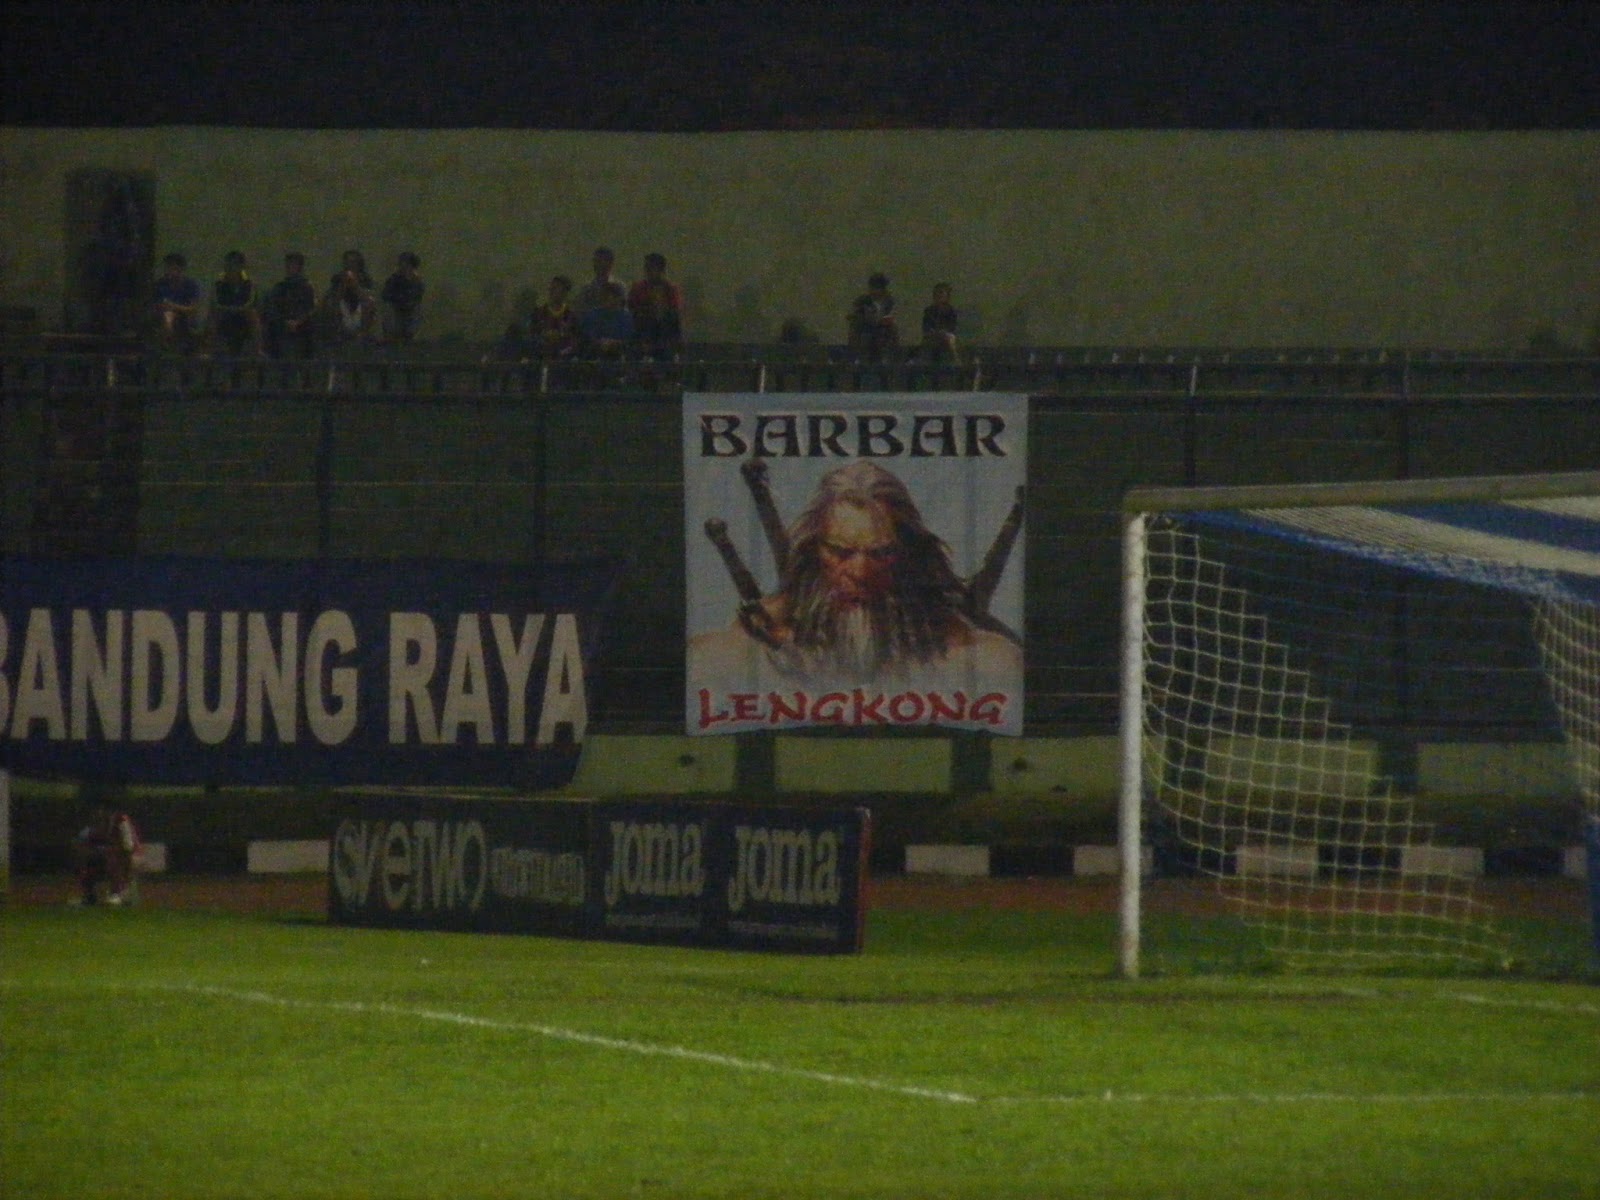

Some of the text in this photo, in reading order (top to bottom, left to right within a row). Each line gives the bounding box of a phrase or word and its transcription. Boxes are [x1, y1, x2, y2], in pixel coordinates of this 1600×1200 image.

[700, 414, 1007, 458] BARBAR
[0, 608, 588, 745] ANDUNG RAYA
[698, 687, 1008, 730] LENGKONG
